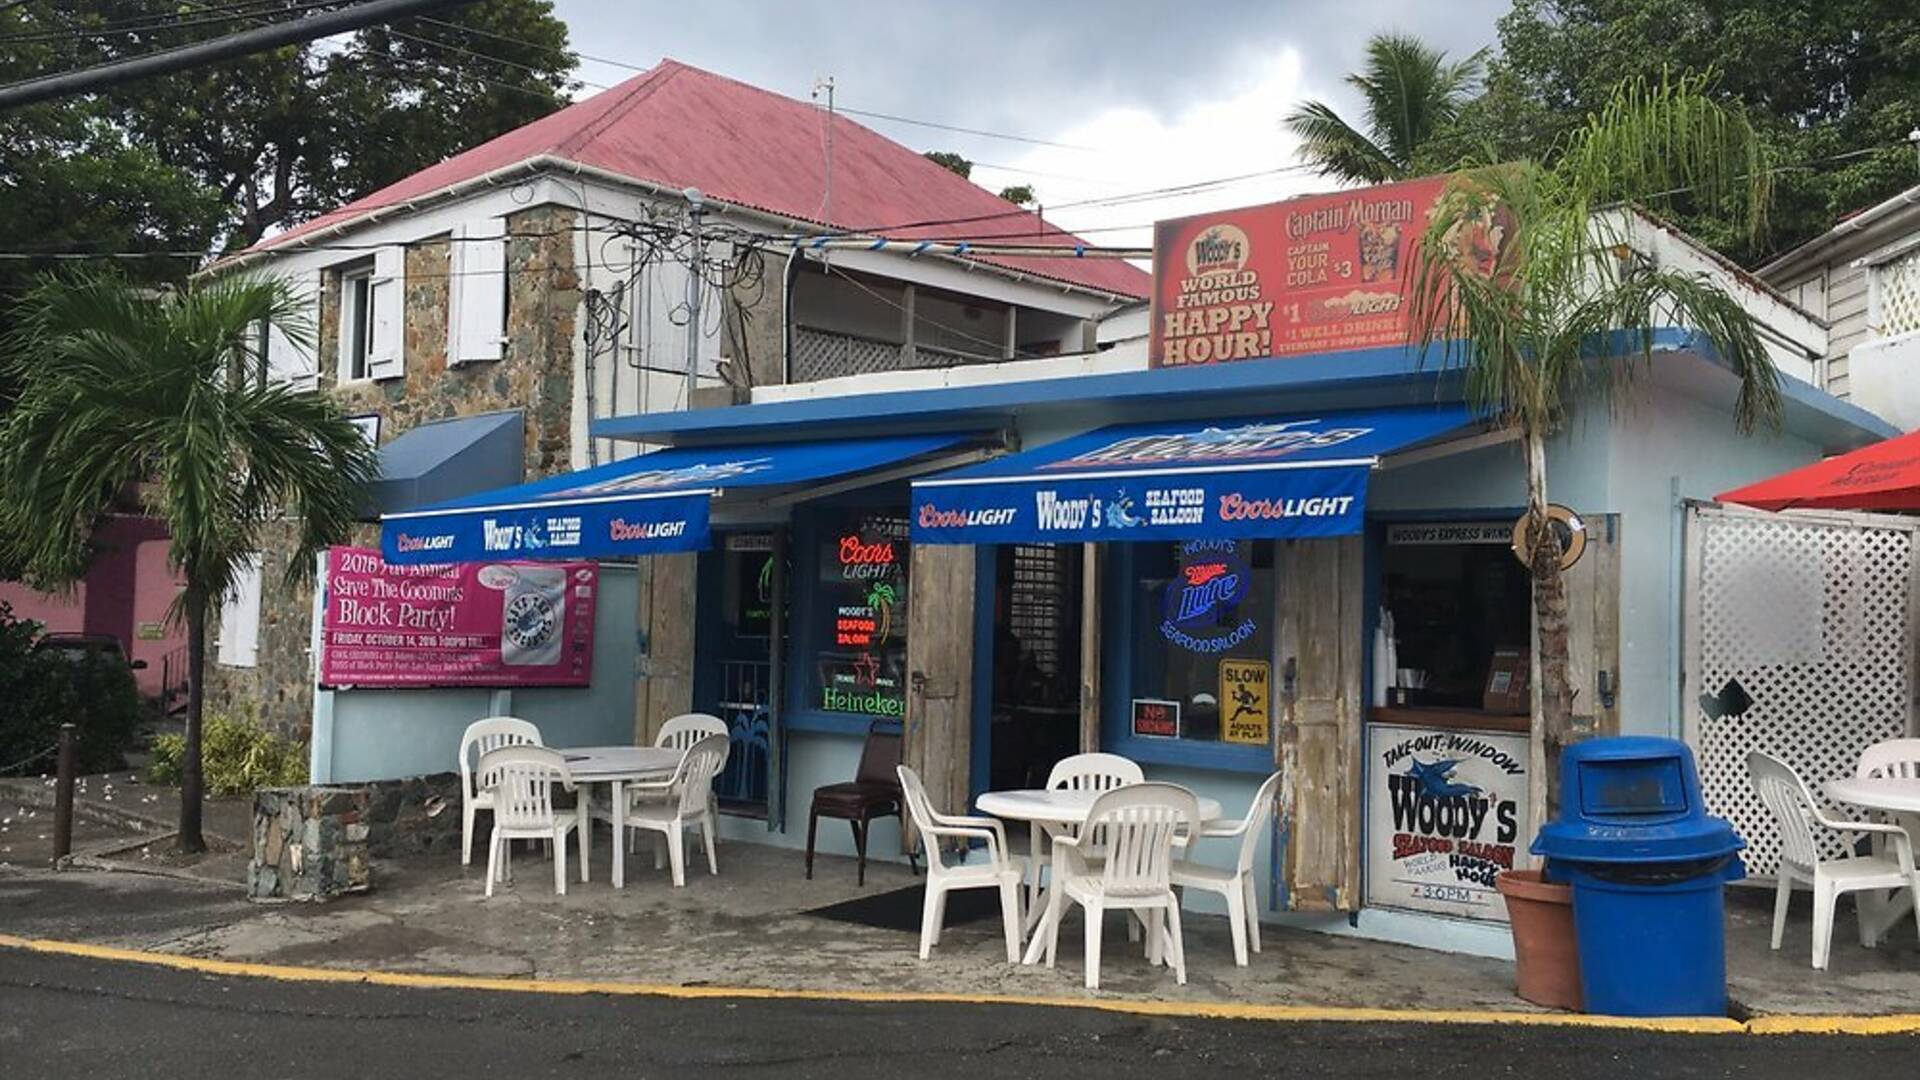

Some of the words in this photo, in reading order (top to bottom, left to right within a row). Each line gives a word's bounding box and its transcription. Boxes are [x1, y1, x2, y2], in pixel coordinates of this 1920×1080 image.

[1286, 204, 1343, 240] Captain
[1344, 199, 1412, 232] Morgan
[1288, 254, 1328, 271] YOUR
[1334, 259, 1352, 278] $3
[1180, 271, 1257, 293] WORLD
[1287, 268, 1328, 286] COLA
[1176, 285, 1260, 309] FAMOUS
[1164, 301, 1274, 338] HAPPY
[1162, 330, 1272, 366] HOUR!
[1146, 488, 1204, 507] SEAFOOD
[1219, 493, 1284, 521] Coors
[1283, 496, 1354, 517] LIGHT
[919, 503, 967, 528] Coors
[966, 508, 1016, 526] LIGHT
[1036, 491, 1101, 530] WOODY'S
[1151, 507, 1204, 525] SALOON
[648, 520, 686, 538] LIGHT
[1482, 526, 1512, 540] WIND
[840, 536, 893, 563] Coors
[843, 562, 889, 578] LIGHT
[333, 576, 368, 597] Save
[371, 578, 398, 598] The
[400, 580, 463, 601] Coconuts
[338, 598, 393, 625] Block
[397, 602, 456, 633] Party!
[365, 633, 404, 647] OCTOBER
[1226, 668, 1266, 683] SLOW
[1447, 735, 1525, 775] WINDOW
[1388, 773, 1517, 843] WOODY'S
[1393, 833, 1453, 860] SEAFOOD
[1458, 841, 1516, 870] SALOON
